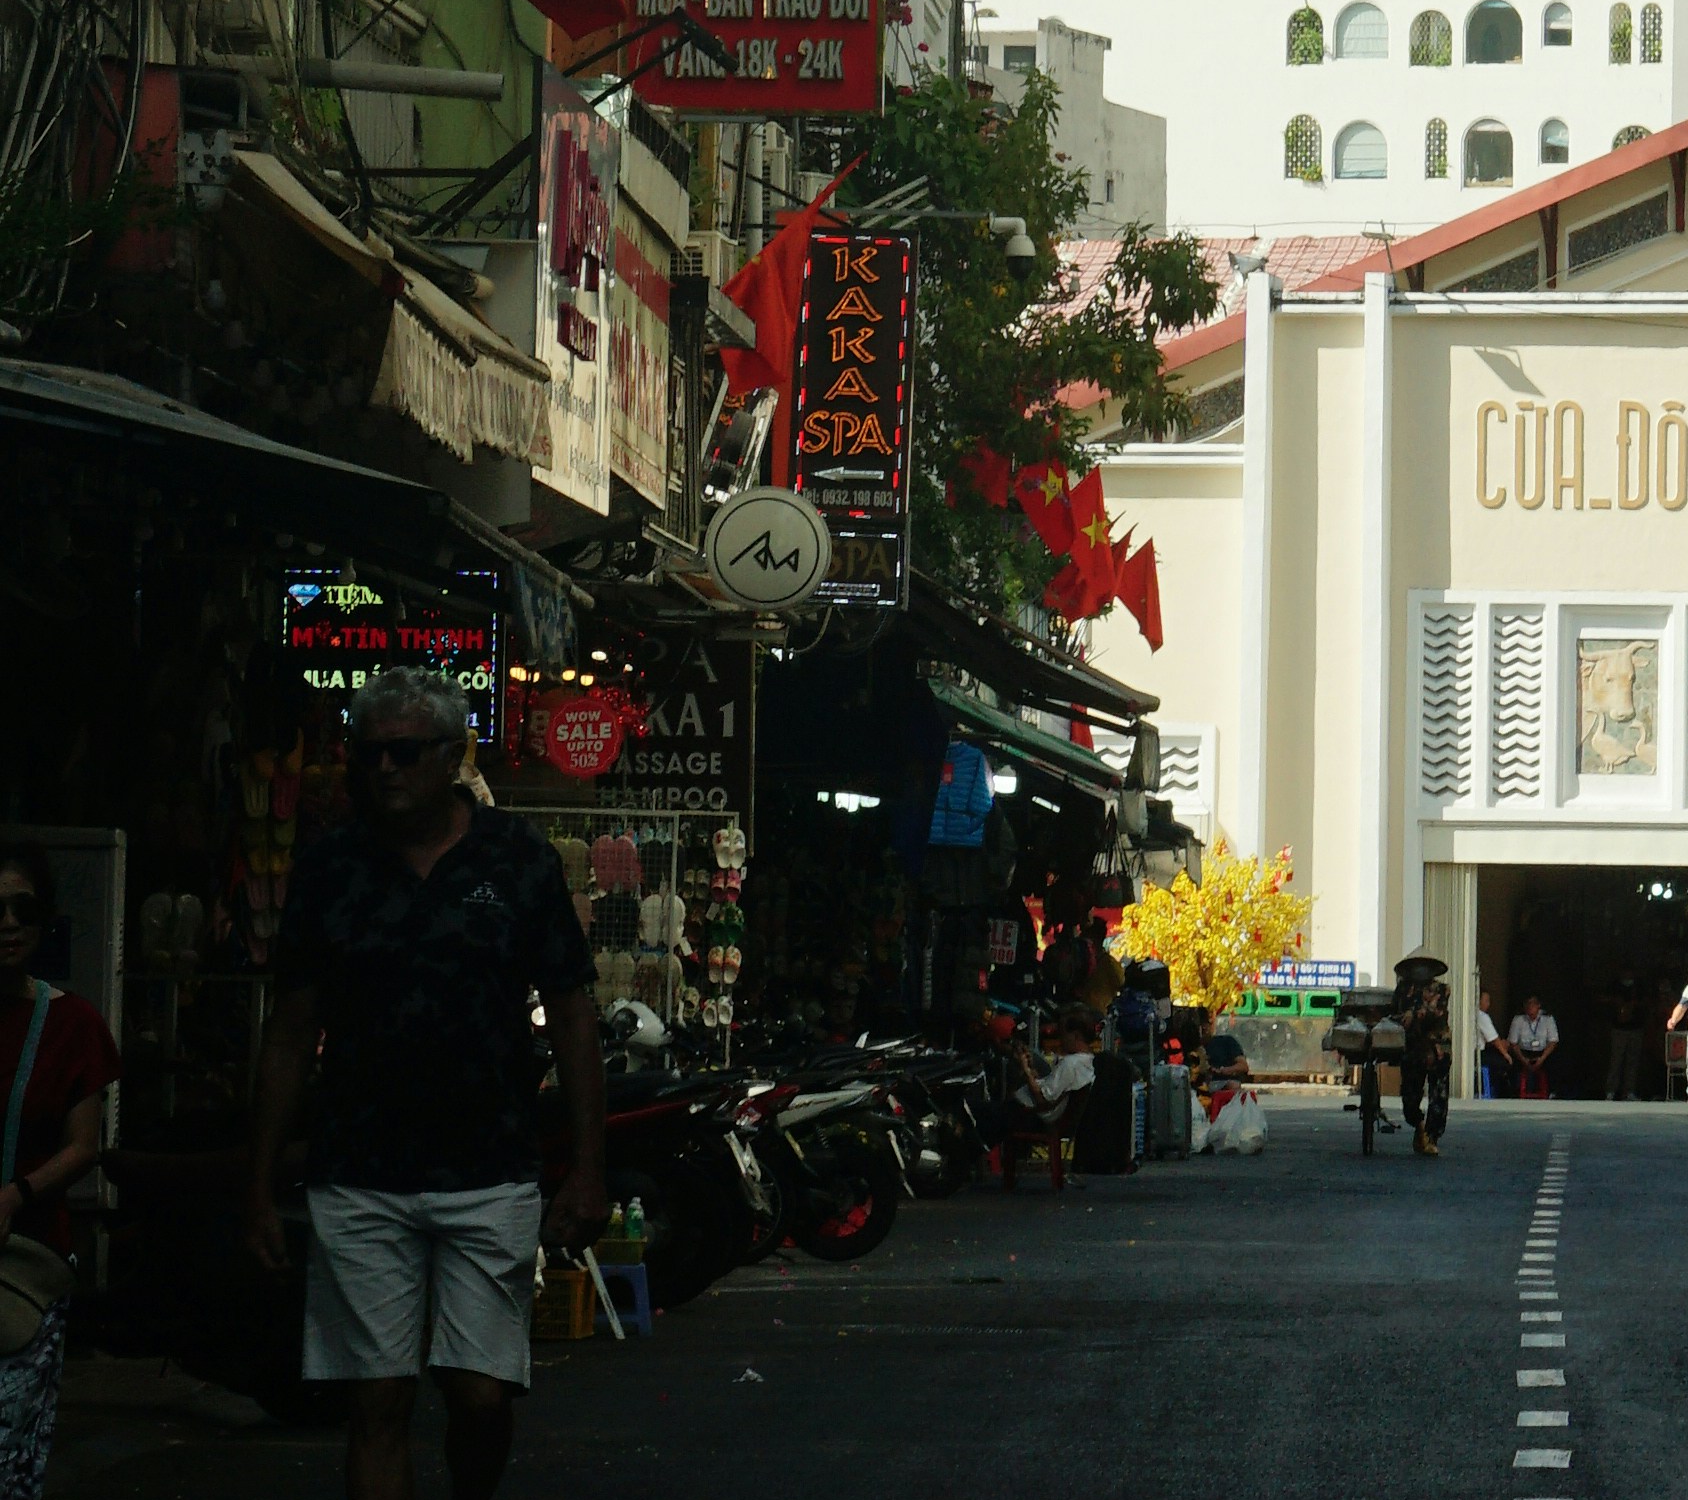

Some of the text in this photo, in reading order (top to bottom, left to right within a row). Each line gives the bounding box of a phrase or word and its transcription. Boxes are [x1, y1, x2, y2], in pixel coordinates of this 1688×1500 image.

[735, 37, 779, 81] 18K
[797, 36, 844, 80] 24K
[824, 246, 879, 402] KAKA
[802, 408, 895, 458] SPA
[556, 722, 613, 742] SALE
[564, 711, 602, 724] WOW
[610, 751, 723, 776] ASSAGE
